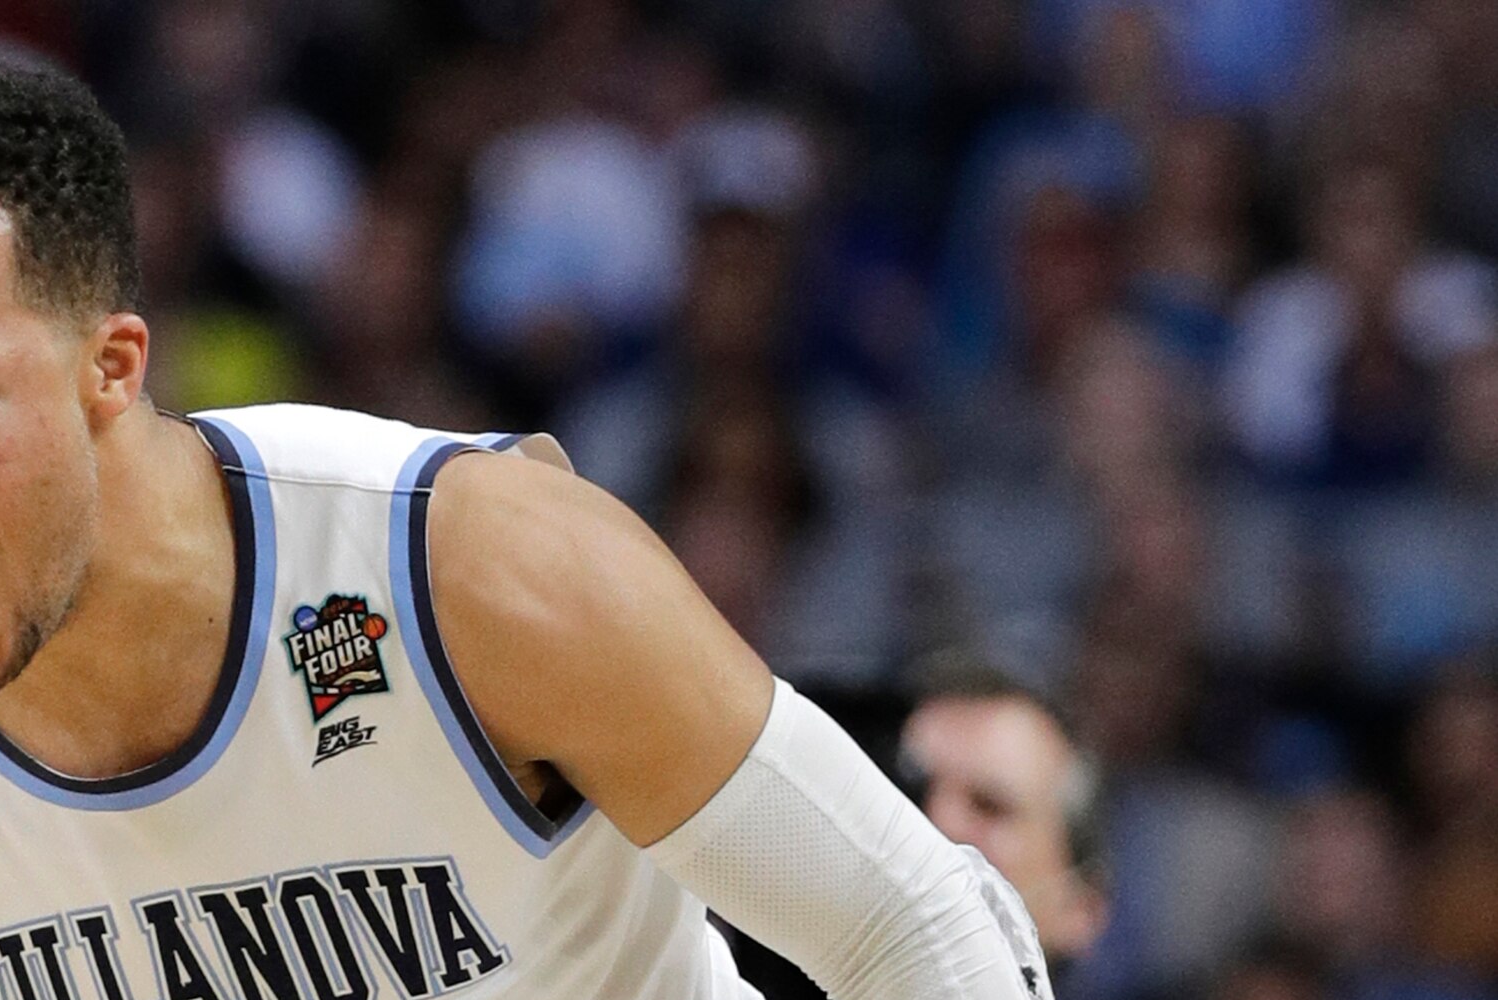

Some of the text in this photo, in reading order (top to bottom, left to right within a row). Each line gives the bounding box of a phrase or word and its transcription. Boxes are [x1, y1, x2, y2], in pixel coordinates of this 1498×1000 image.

[289, 613, 363, 667] FINAL
[305, 635, 374, 685] FOUR
[315, 726, 378, 757] EAST
[318, 715, 361, 742] BIG
